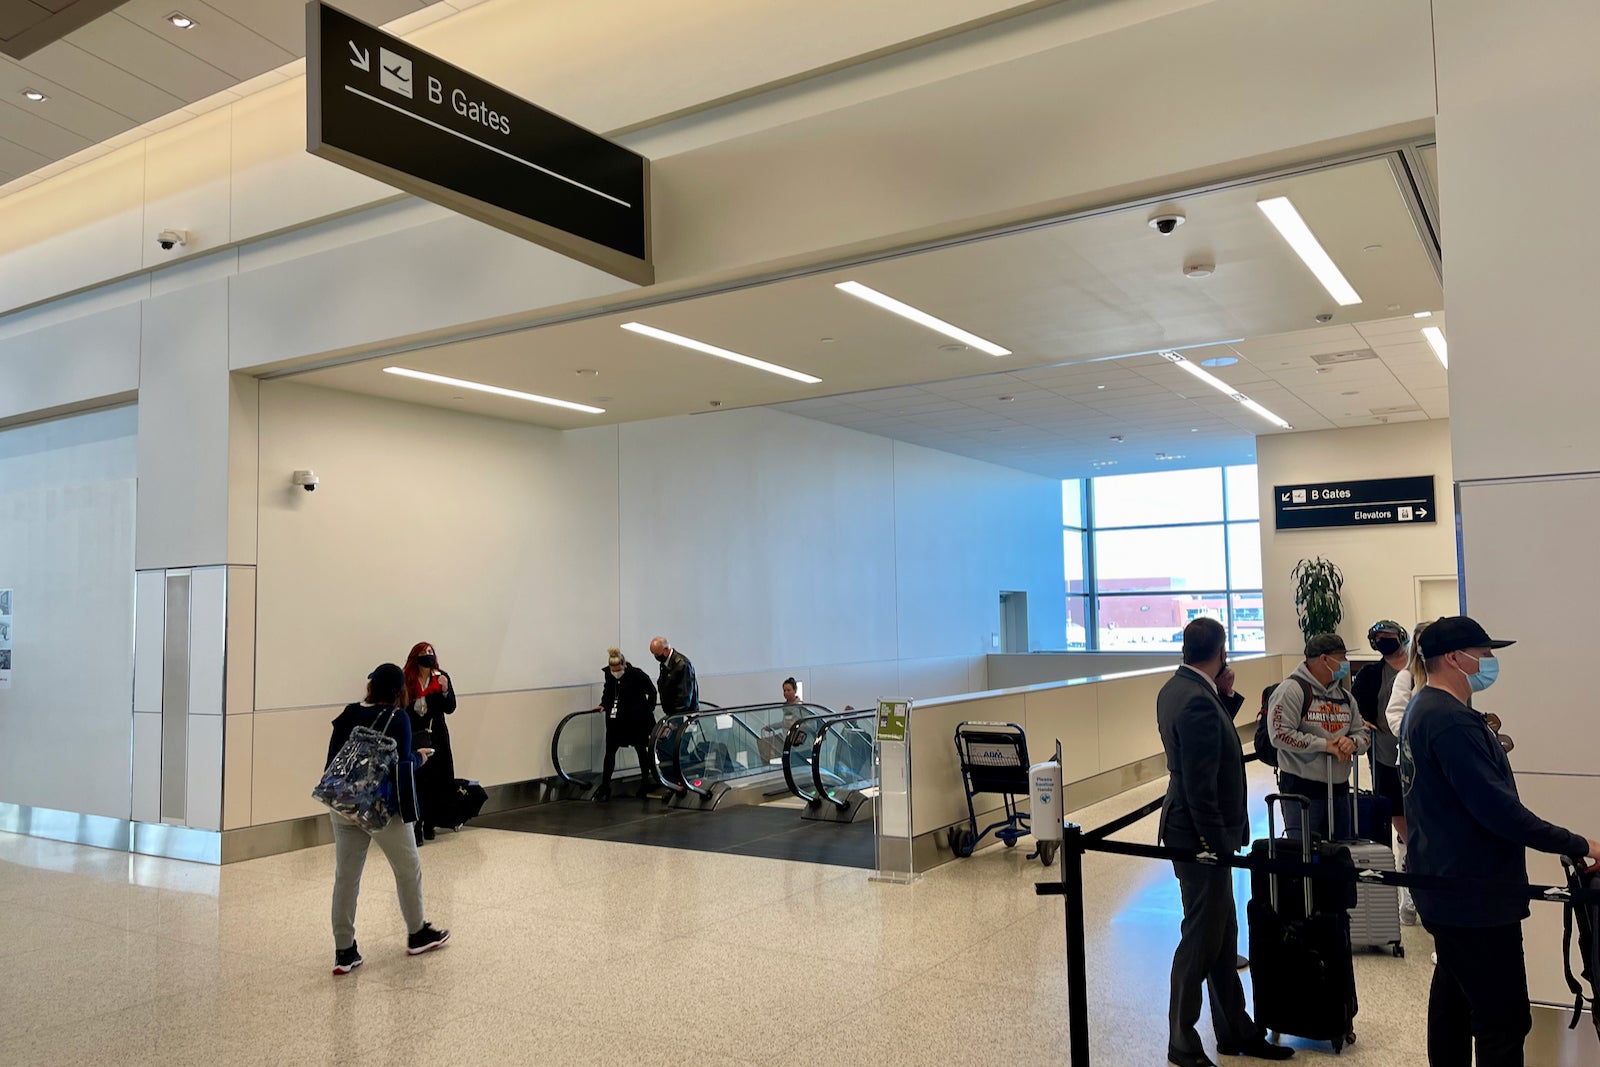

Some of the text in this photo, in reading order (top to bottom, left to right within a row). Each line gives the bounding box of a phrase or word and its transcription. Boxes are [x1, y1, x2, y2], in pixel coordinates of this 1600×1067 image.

[428, 75, 511, 135] B Gates
[1311, 488, 1351, 500] B Gates
[1354, 510, 1392, 520] Elevators
